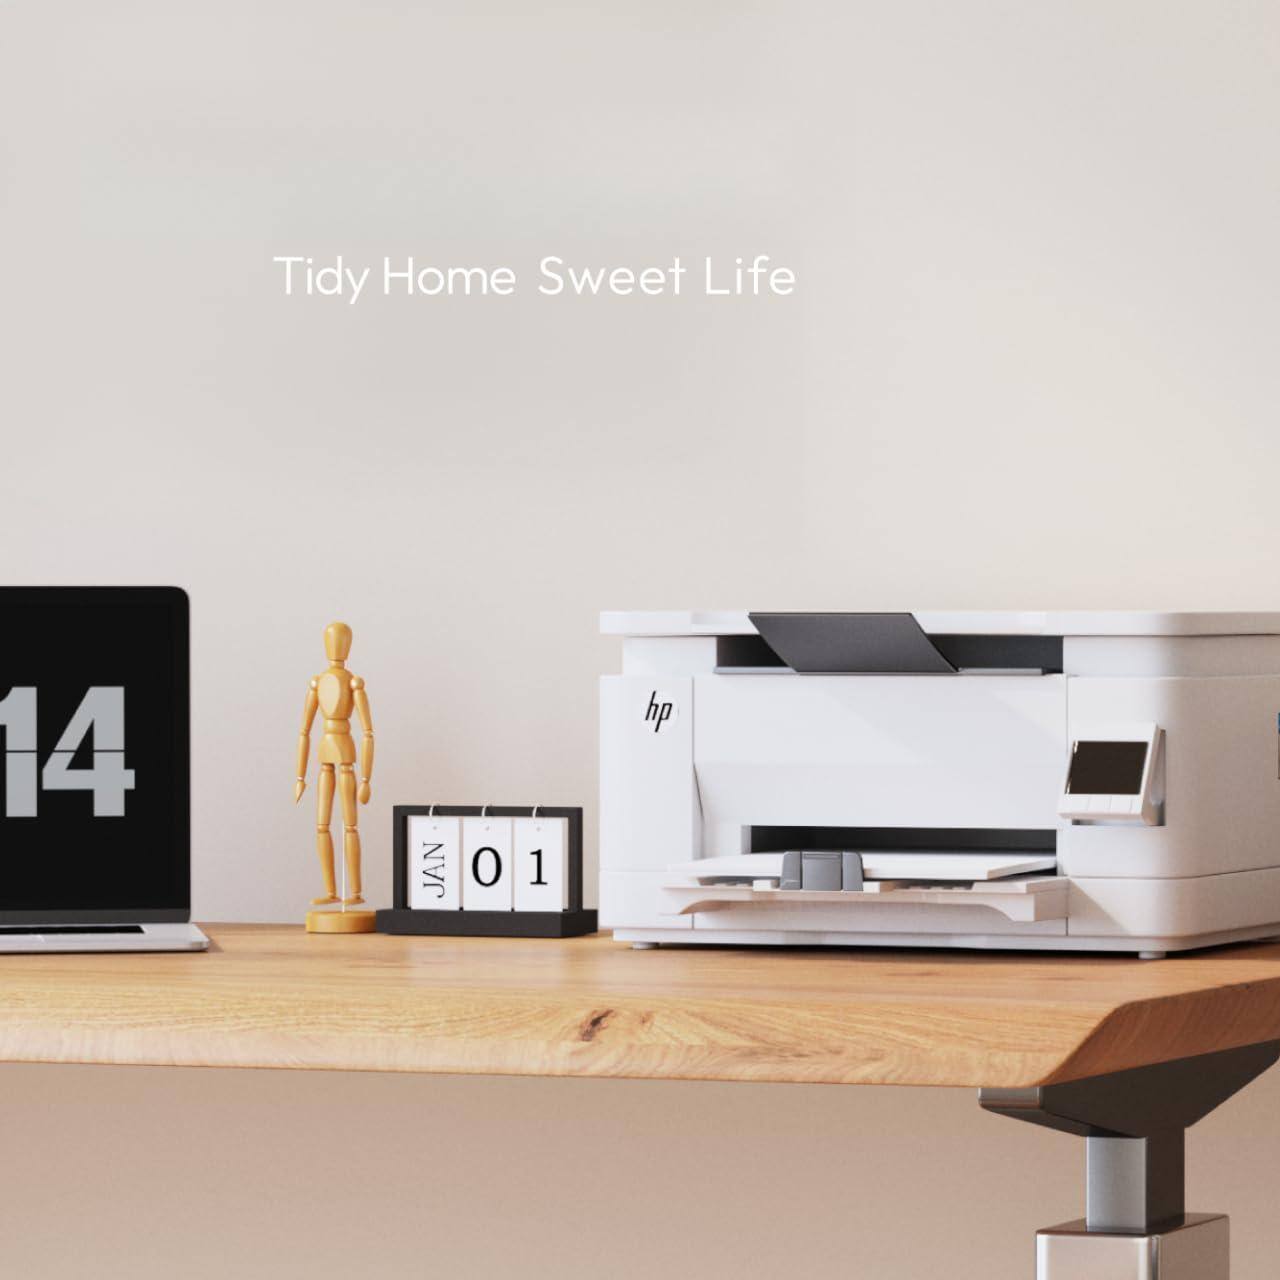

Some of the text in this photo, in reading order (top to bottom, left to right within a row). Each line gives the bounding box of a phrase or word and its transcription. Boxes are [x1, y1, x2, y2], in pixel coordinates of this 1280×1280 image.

[645, 690, 673, 733] hp
[0, 686, 136, 818] 14
[422, 841, 446, 899] JAN
